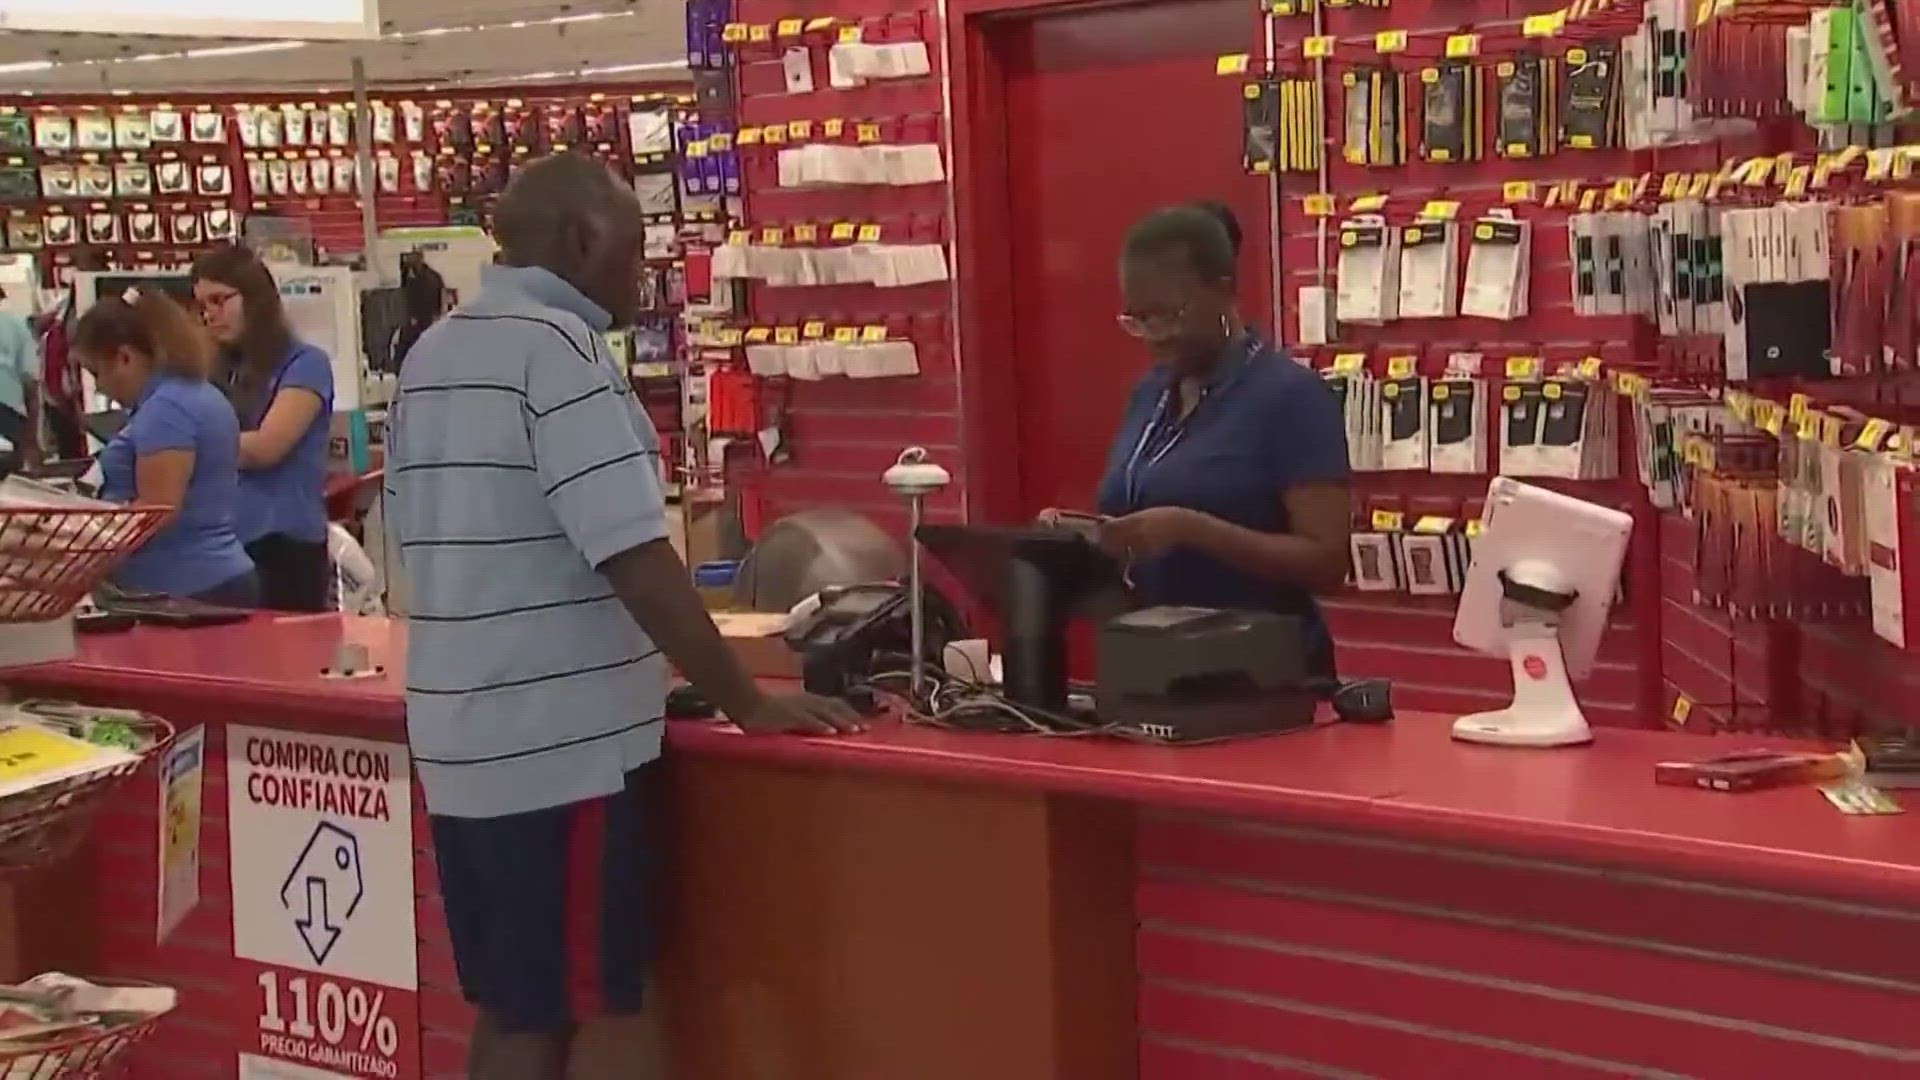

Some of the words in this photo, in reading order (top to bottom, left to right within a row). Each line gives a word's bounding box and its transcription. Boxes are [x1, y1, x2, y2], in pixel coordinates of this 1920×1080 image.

[247, 738, 338, 774] COMPRA
[343, 749, 389, 782] CON
[248, 774, 389, 821] CONFIANZA
[258, 971, 397, 1056] 110%
[261, 1033, 306, 1059] PRECIO
[308, 1042, 397, 1079] GARANTIZADO
